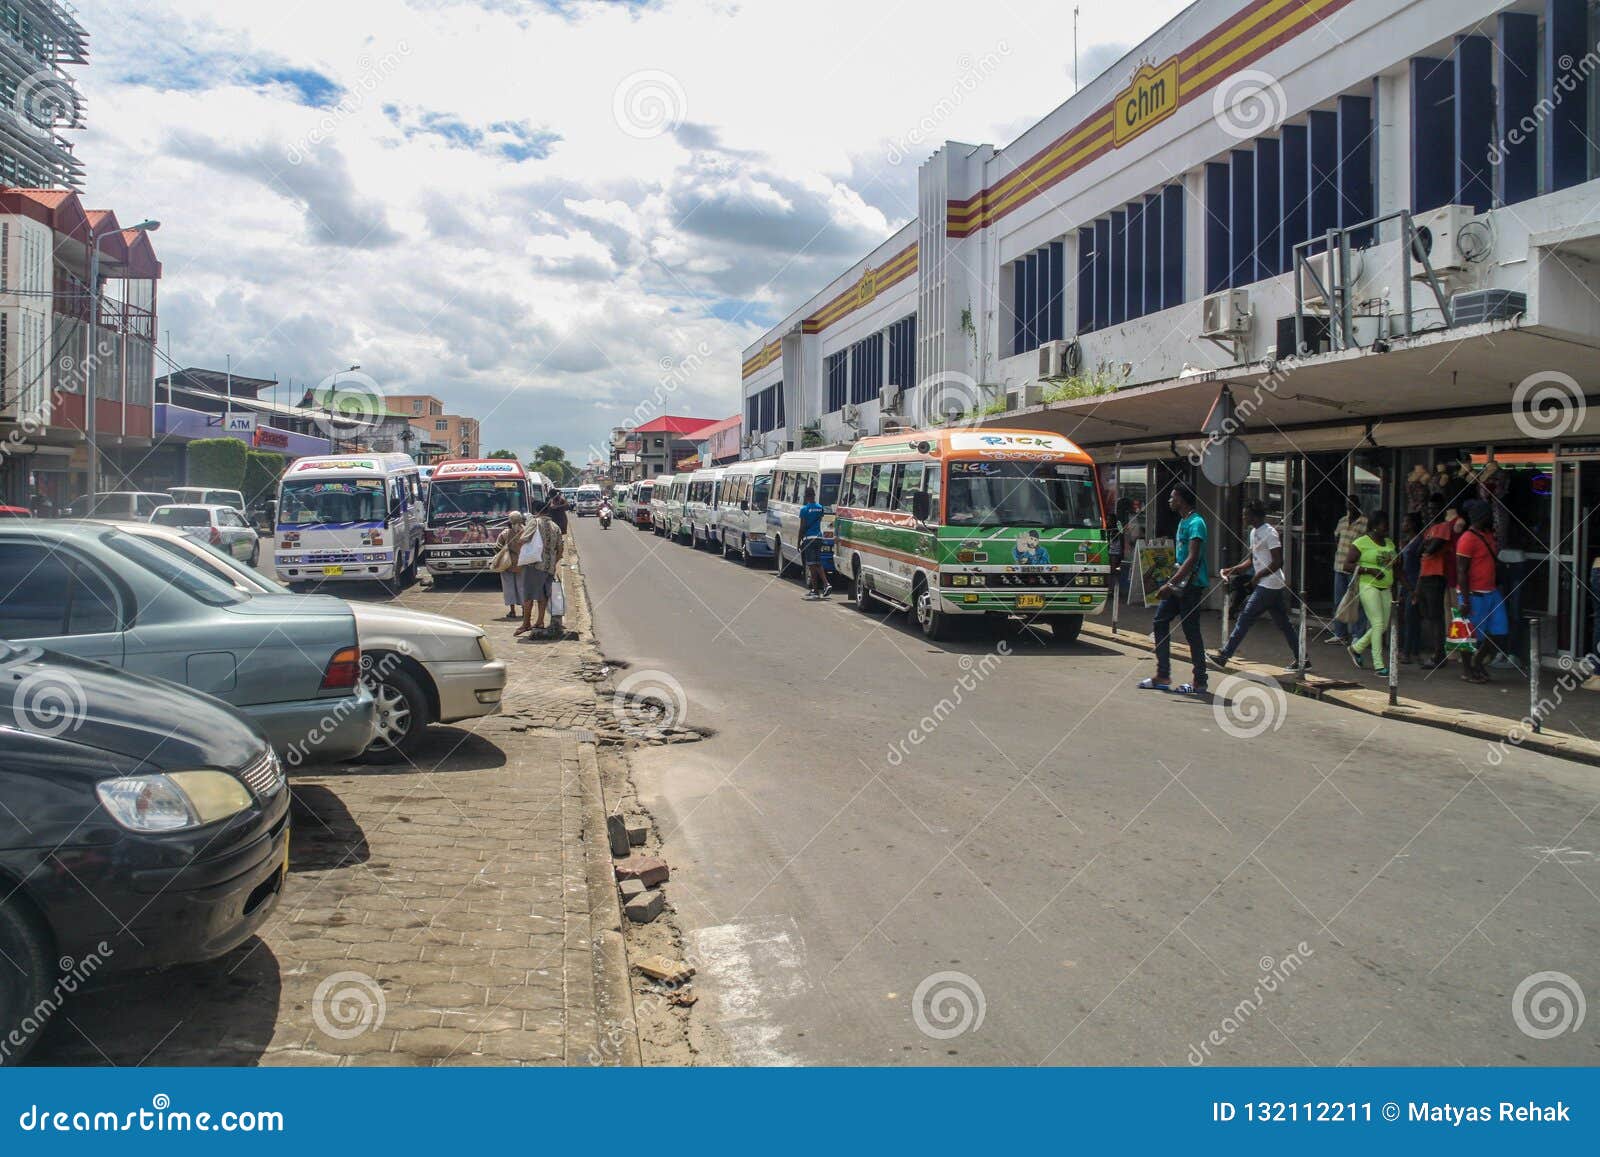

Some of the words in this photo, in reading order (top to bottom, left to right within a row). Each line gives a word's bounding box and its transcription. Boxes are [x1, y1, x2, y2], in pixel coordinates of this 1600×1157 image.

[1125, 78, 1165, 126] chm
[230, 420, 250, 430] ATM
[980, 436, 1052, 449] RICK
[951, 463, 990, 474] RICK
